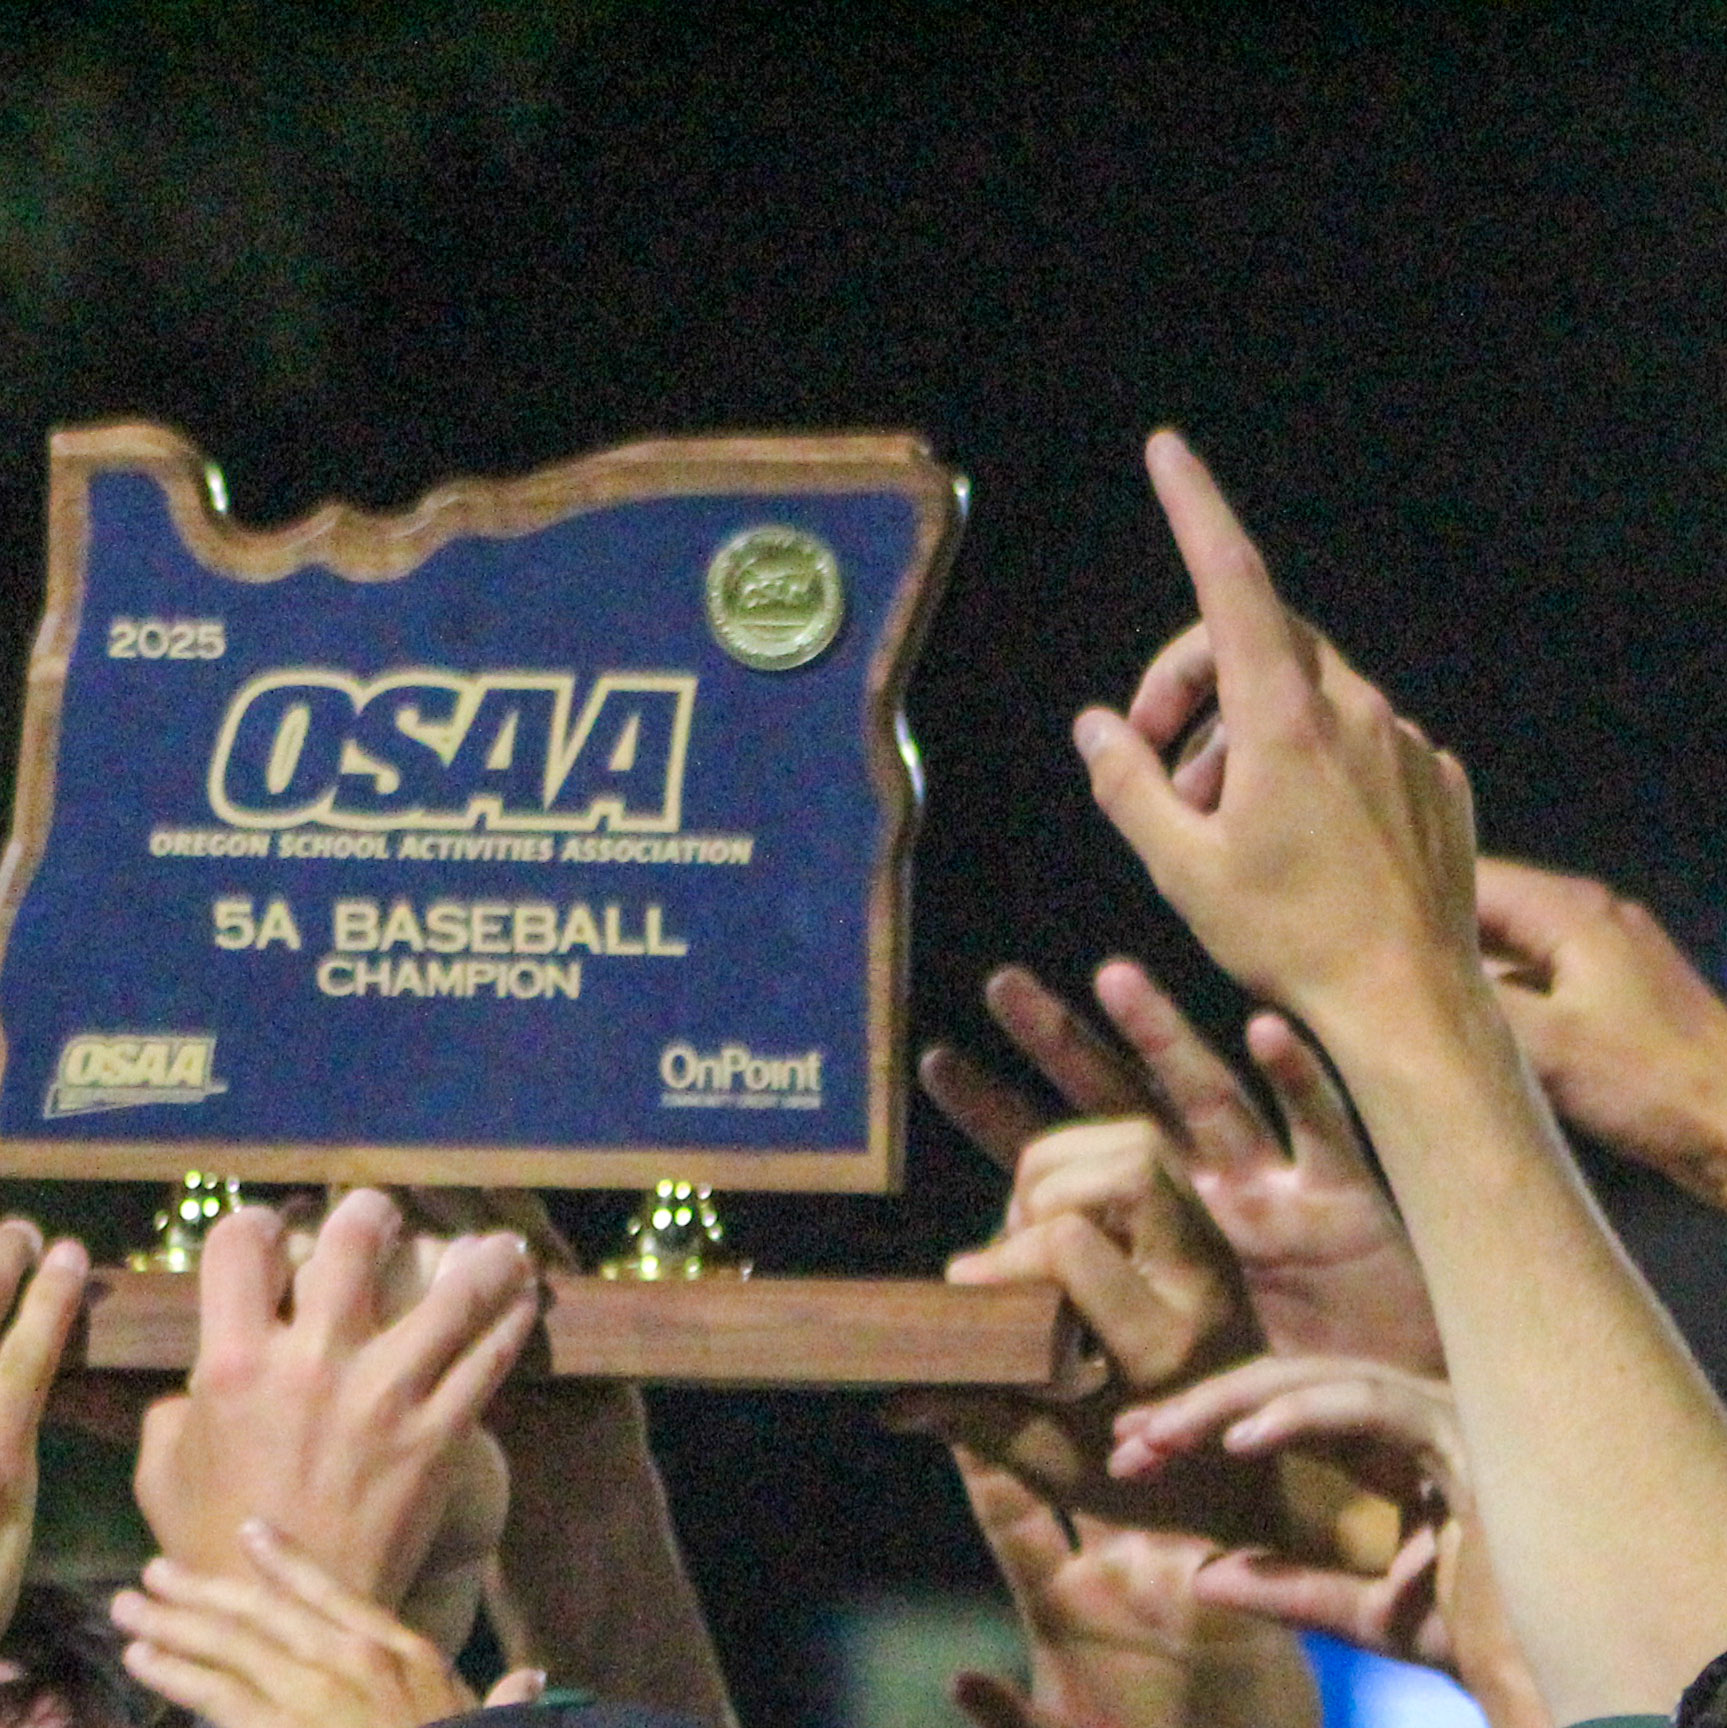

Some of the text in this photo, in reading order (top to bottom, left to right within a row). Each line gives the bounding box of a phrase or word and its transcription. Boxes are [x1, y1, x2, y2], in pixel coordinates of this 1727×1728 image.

[108, 623, 225, 660] 2025
[207, 670, 698, 832] OSAA
[150, 832, 754, 865] OREGON SCHOOL ACTIVITIES ASSOCIATION
[213, 901, 688, 956] 5A BASEBALL
[317, 959, 583, 1000] CHAMPION
[60, 1036, 215, 1090] OSAA
[660, 1041, 821, 1091] OnPoint
